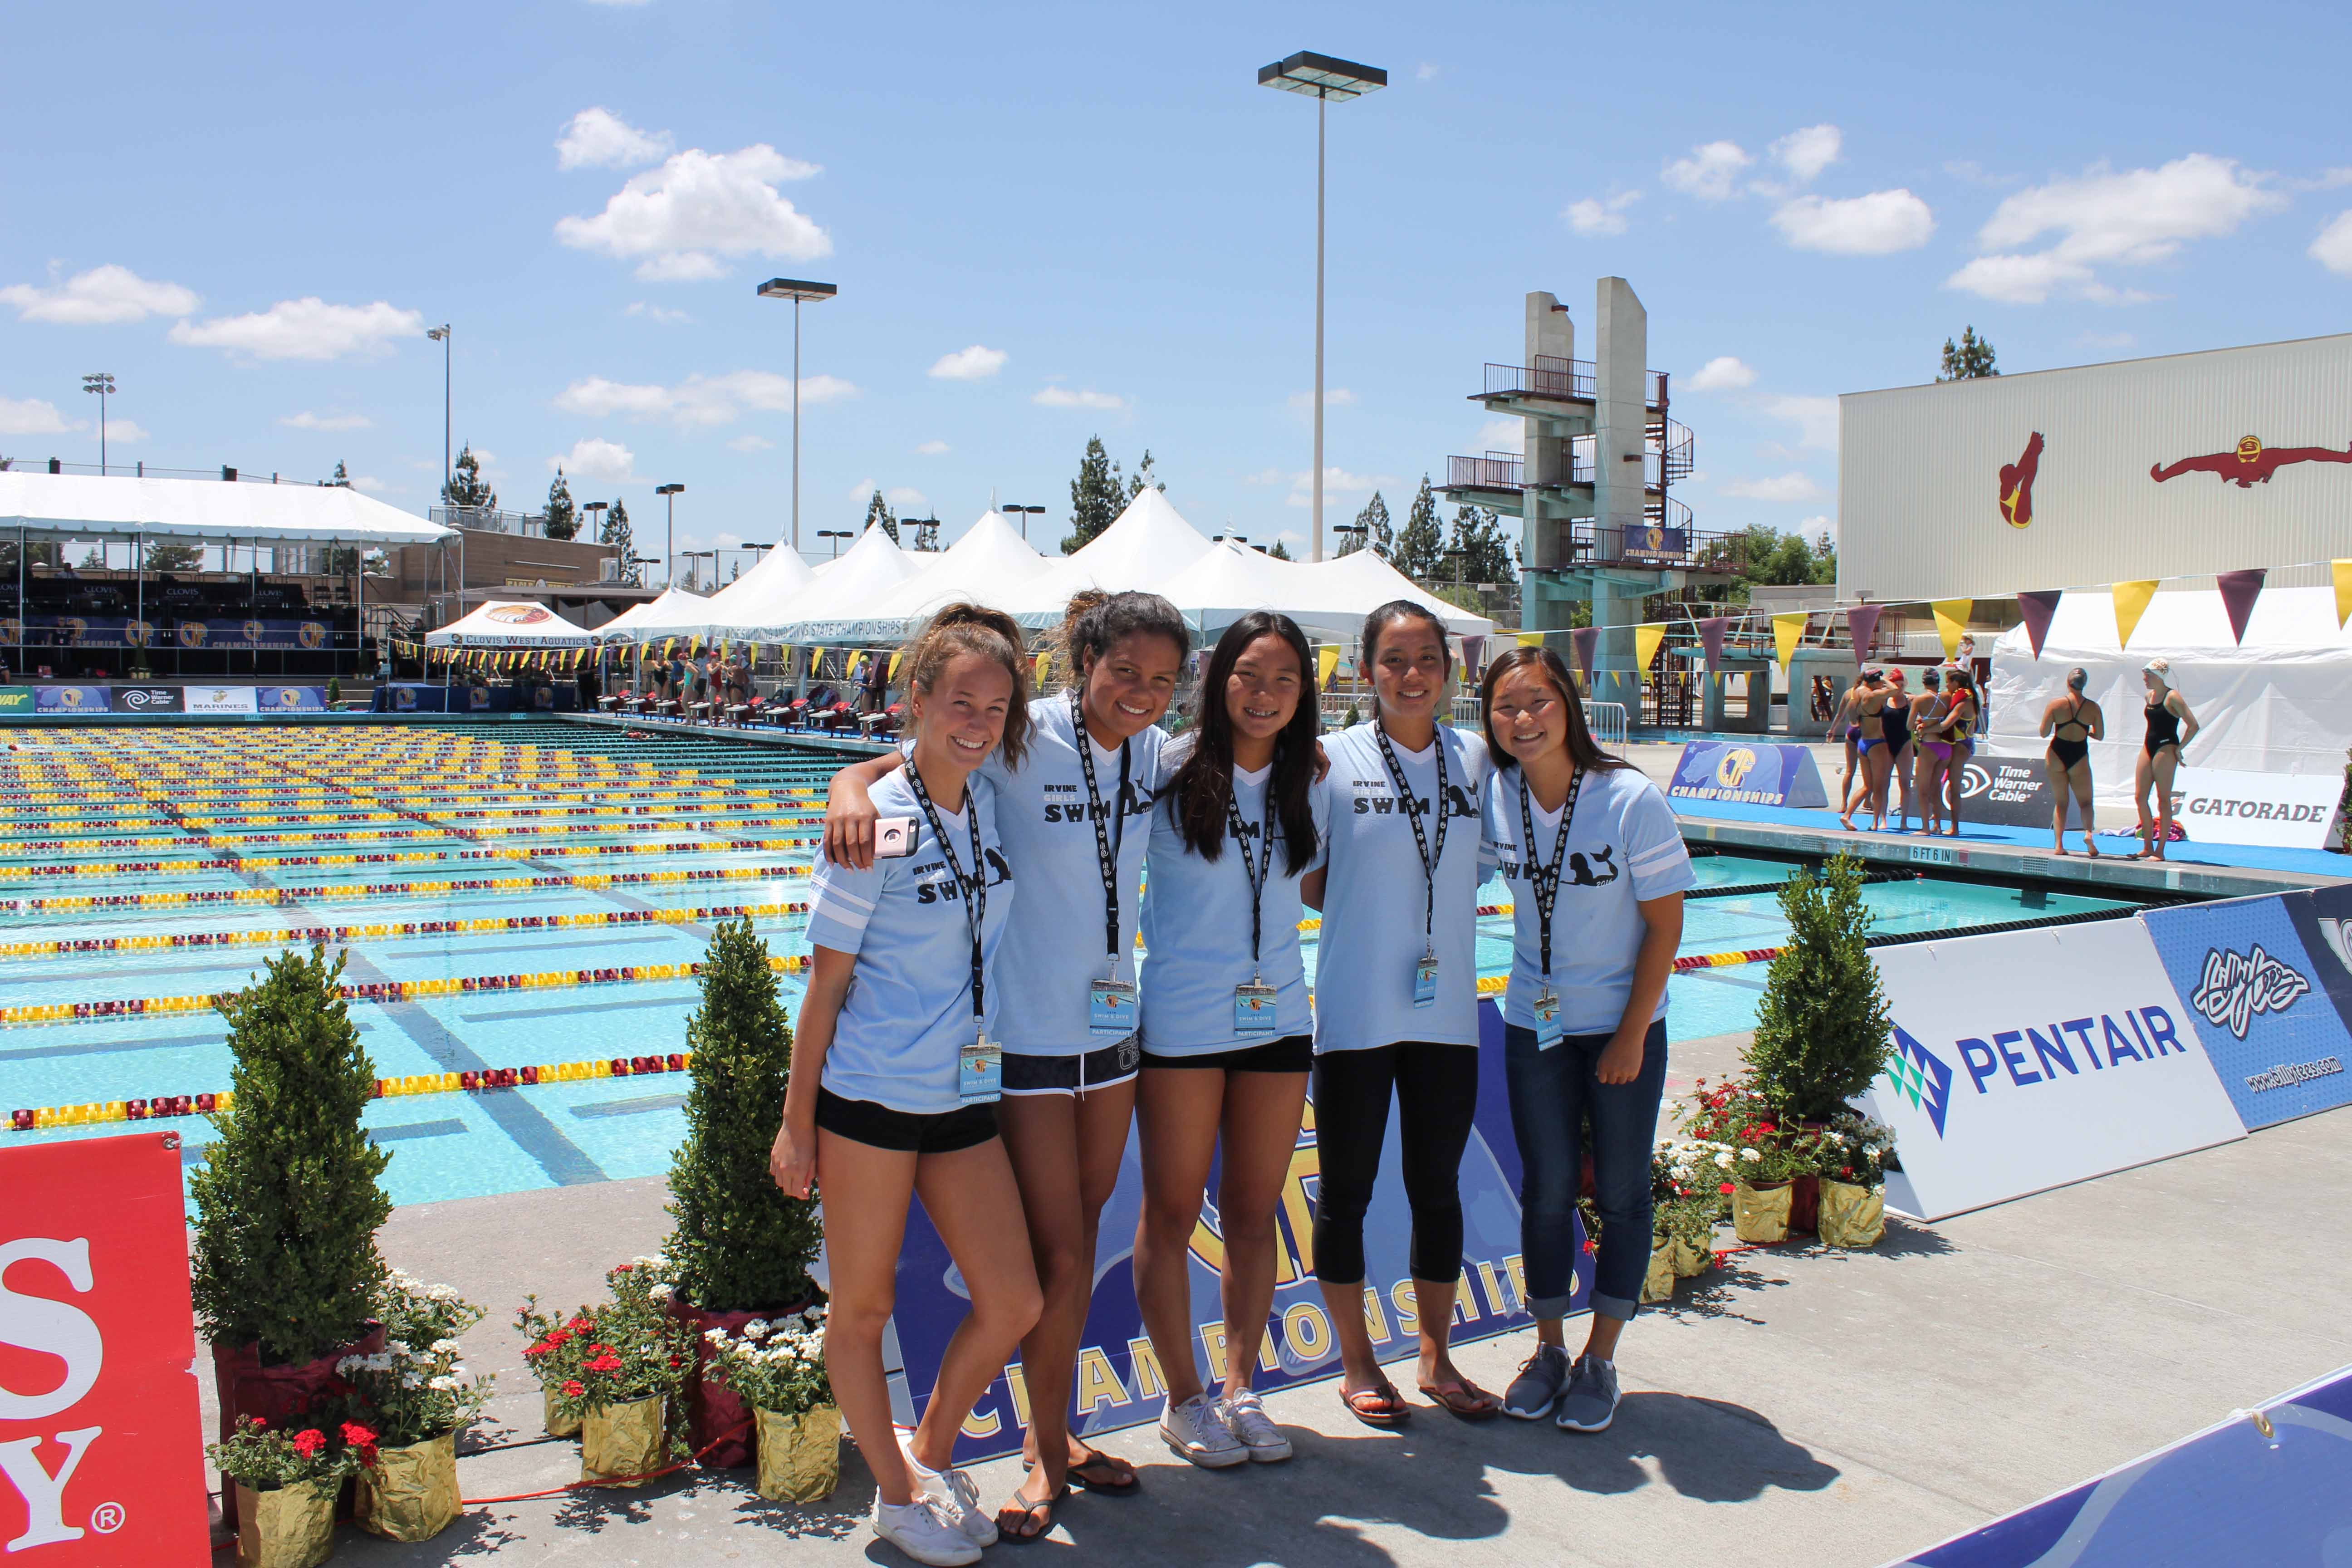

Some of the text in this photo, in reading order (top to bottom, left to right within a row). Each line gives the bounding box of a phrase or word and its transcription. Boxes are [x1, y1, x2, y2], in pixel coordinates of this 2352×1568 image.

[811, 622, 834, 636] STATE
[835, 620, 901, 636] CHAMPIONSHIPS
[466, 635, 588, 646] CLOVIS WEST AQUATICS
[1999, 765, 2031, 778] Time
[1994, 777, 2043, 791] Warner
[1671, 785, 1784, 805] CHAMPIONSHIPS
[2189, 798, 2328, 823] GATORADE
[1913, 847, 1950, 862] 6 FT 6 IN
[912, 861, 946, 875] IRVINE
[1596, 877, 1612, 888] 2016
[1955, 1005, 2187, 1094] PENTAIR
[2244, 1056, 2345, 1094] www.billytees.com
[961, 1094, 999, 1104] PARTICIPANT
